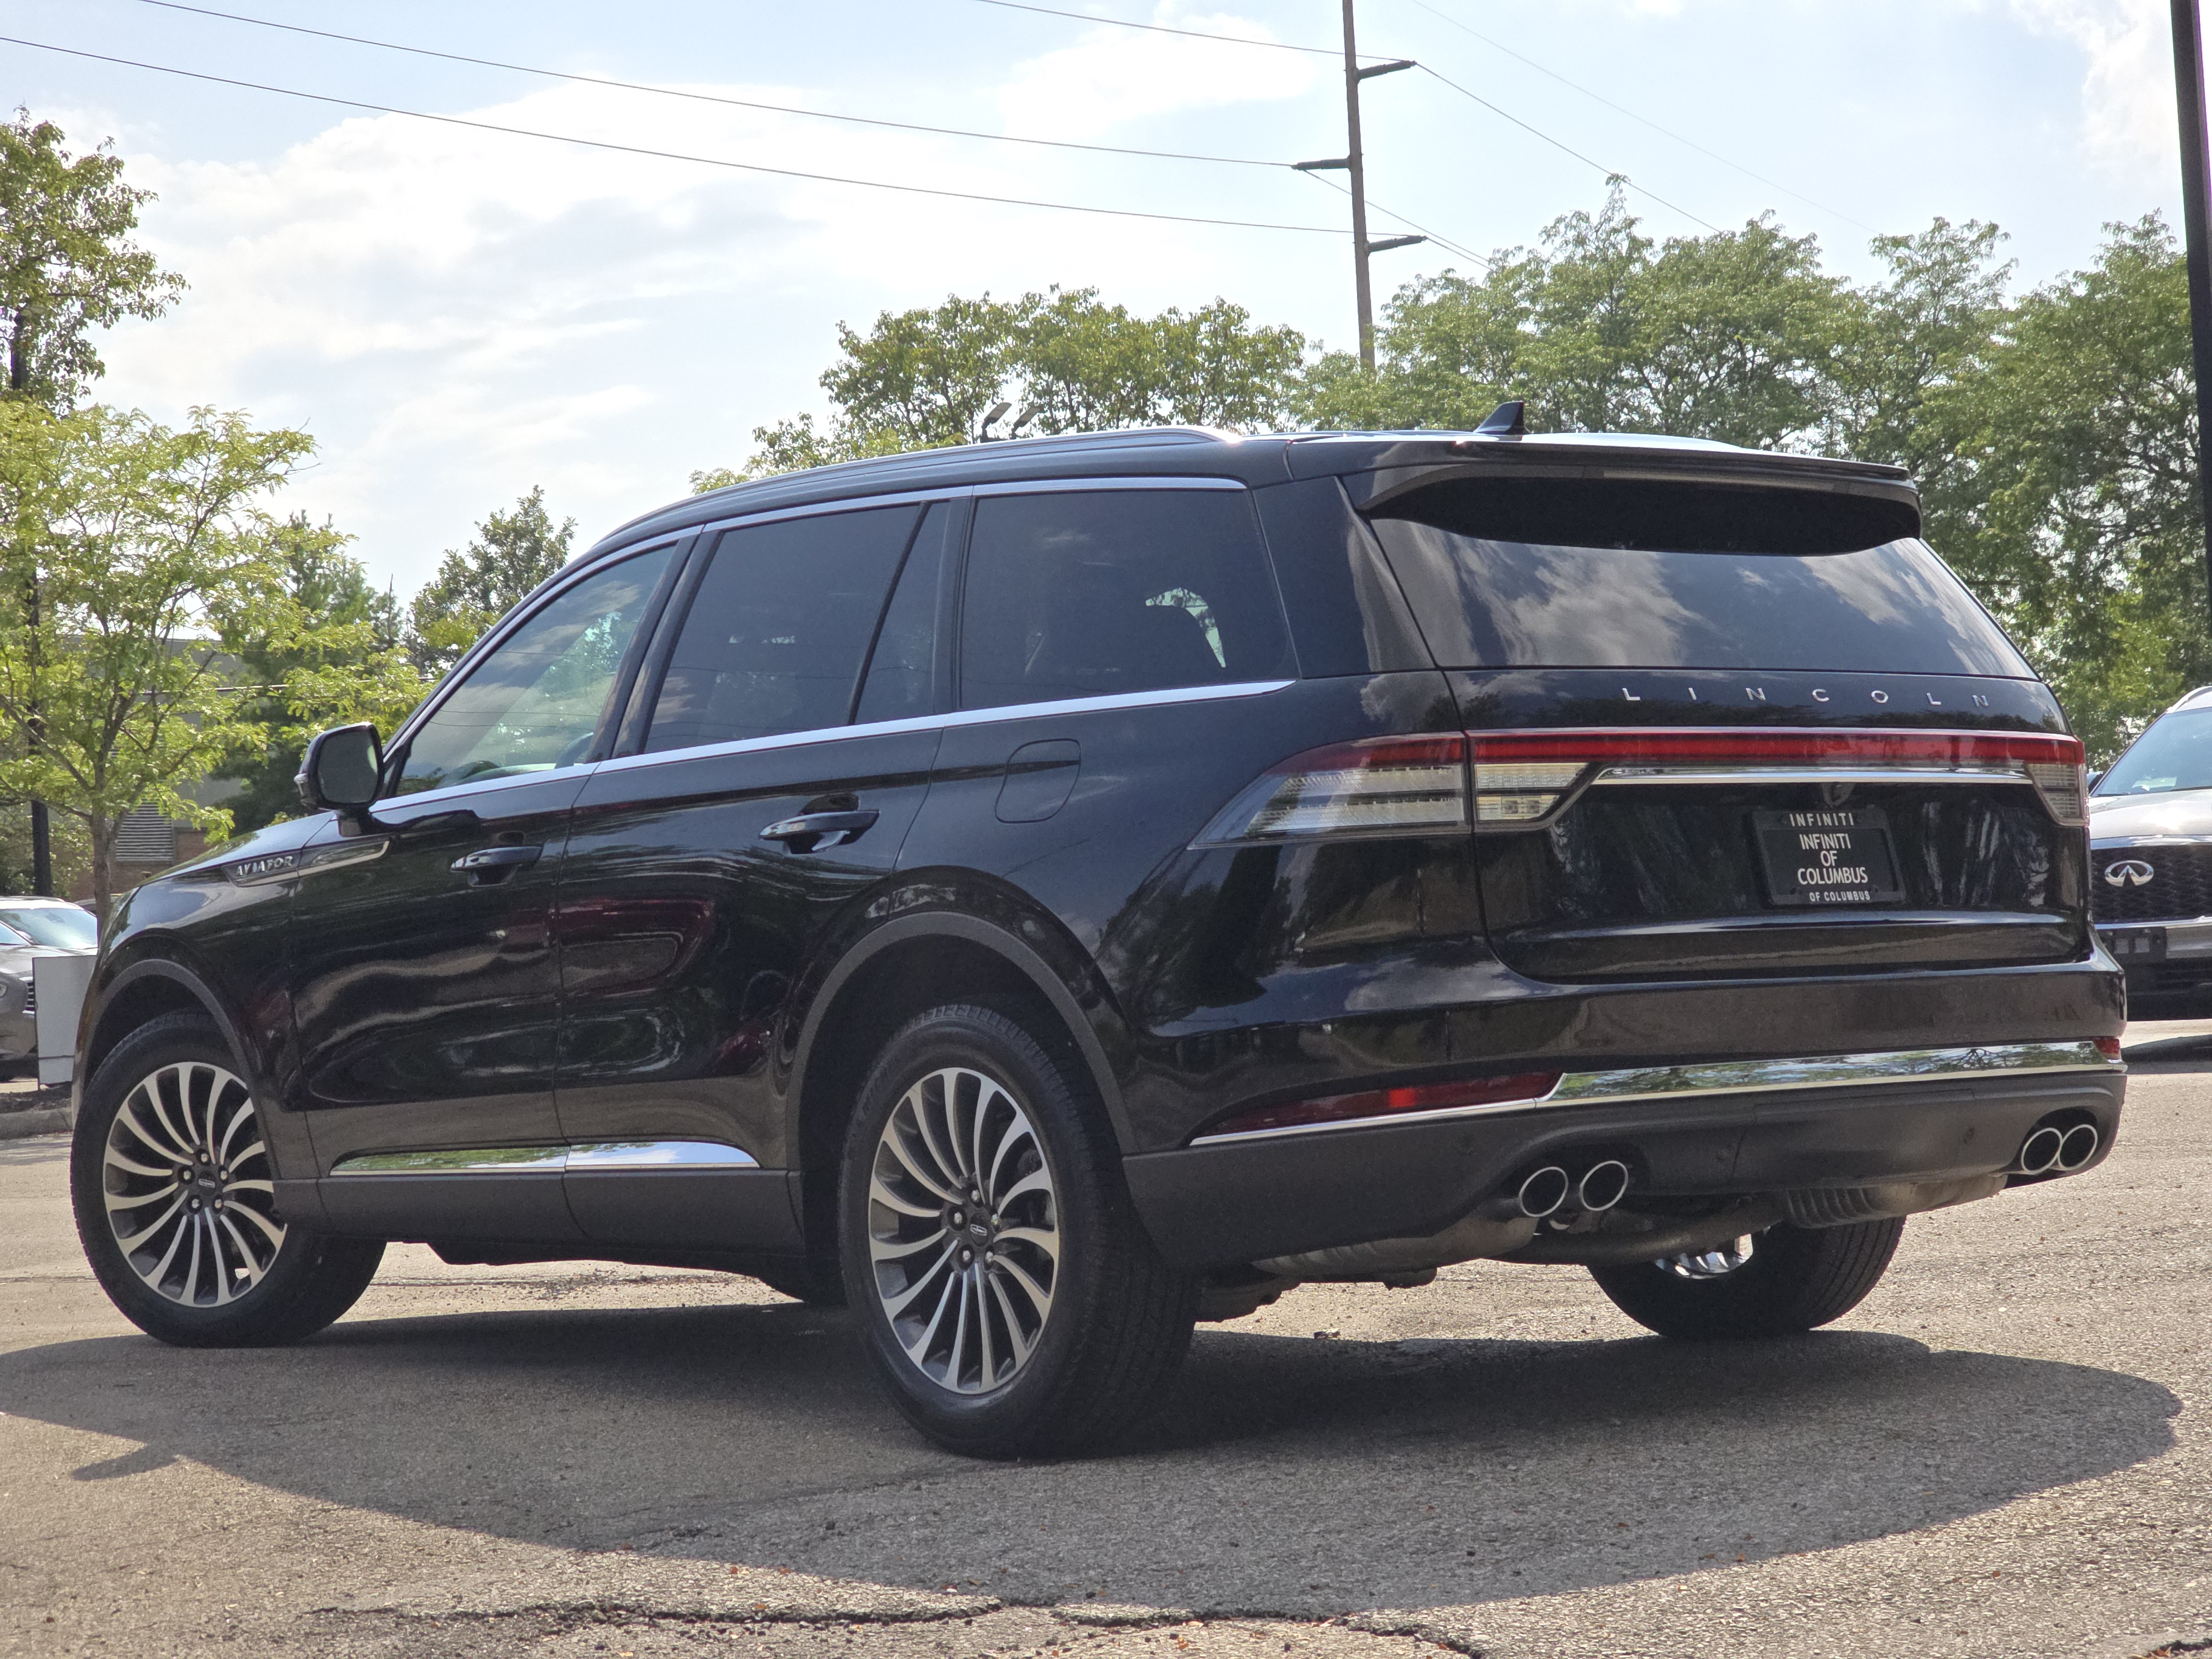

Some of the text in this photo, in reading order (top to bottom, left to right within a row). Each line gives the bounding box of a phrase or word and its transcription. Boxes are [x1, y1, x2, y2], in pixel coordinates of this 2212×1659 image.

[1622, 687, 1989, 708] LINCOLN
[1790, 812, 1854, 827] INFINITI
[1799, 833, 1851, 850] INFINITI
[236, 855, 293, 875] AVIATOR
[1820, 850, 1837, 867] OF
[1797, 867, 1868, 885] COLUMBUS
[1809, 890, 1871, 902] OF COLUMBUS
